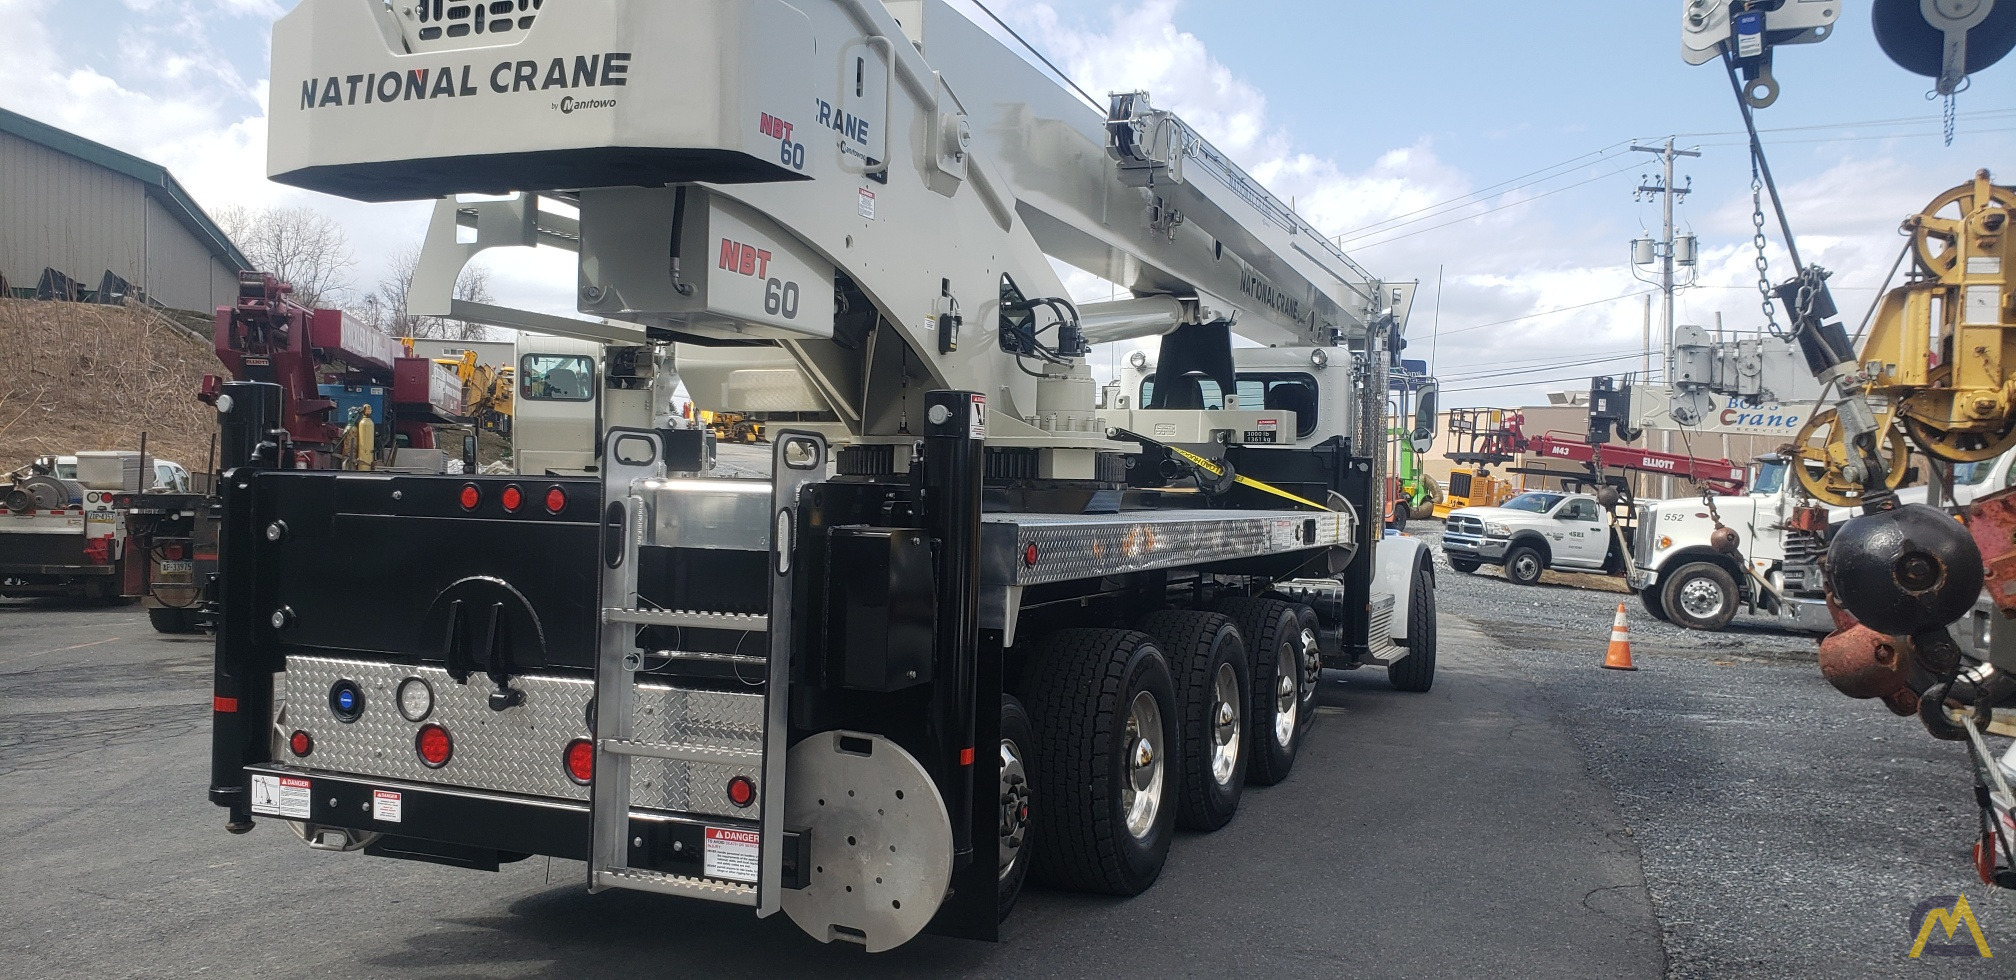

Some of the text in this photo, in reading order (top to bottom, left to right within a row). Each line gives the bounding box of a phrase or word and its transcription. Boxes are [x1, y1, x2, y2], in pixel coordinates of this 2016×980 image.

[300, 52, 632, 111] NATIONAL CRANE
[551, 102, 559, 111] by
[760, 112, 793, 142] NBT
[816, 98, 869, 146] RANE
[781, 139, 805, 170] 60
[719, 238, 772, 280] NBT
[764, 277, 799, 319] 60
[1240, 270, 1275, 308] NATIONAL
[1276, 292, 1299, 320] CRANE
[1720, 409, 1798, 428] Crane
[1552, 446, 1569, 455] M43
[1642, 457, 1674, 470] ELLIOTT
[1664, 513, 1684, 522] 552
[724, 831, 759, 843] DANGER
